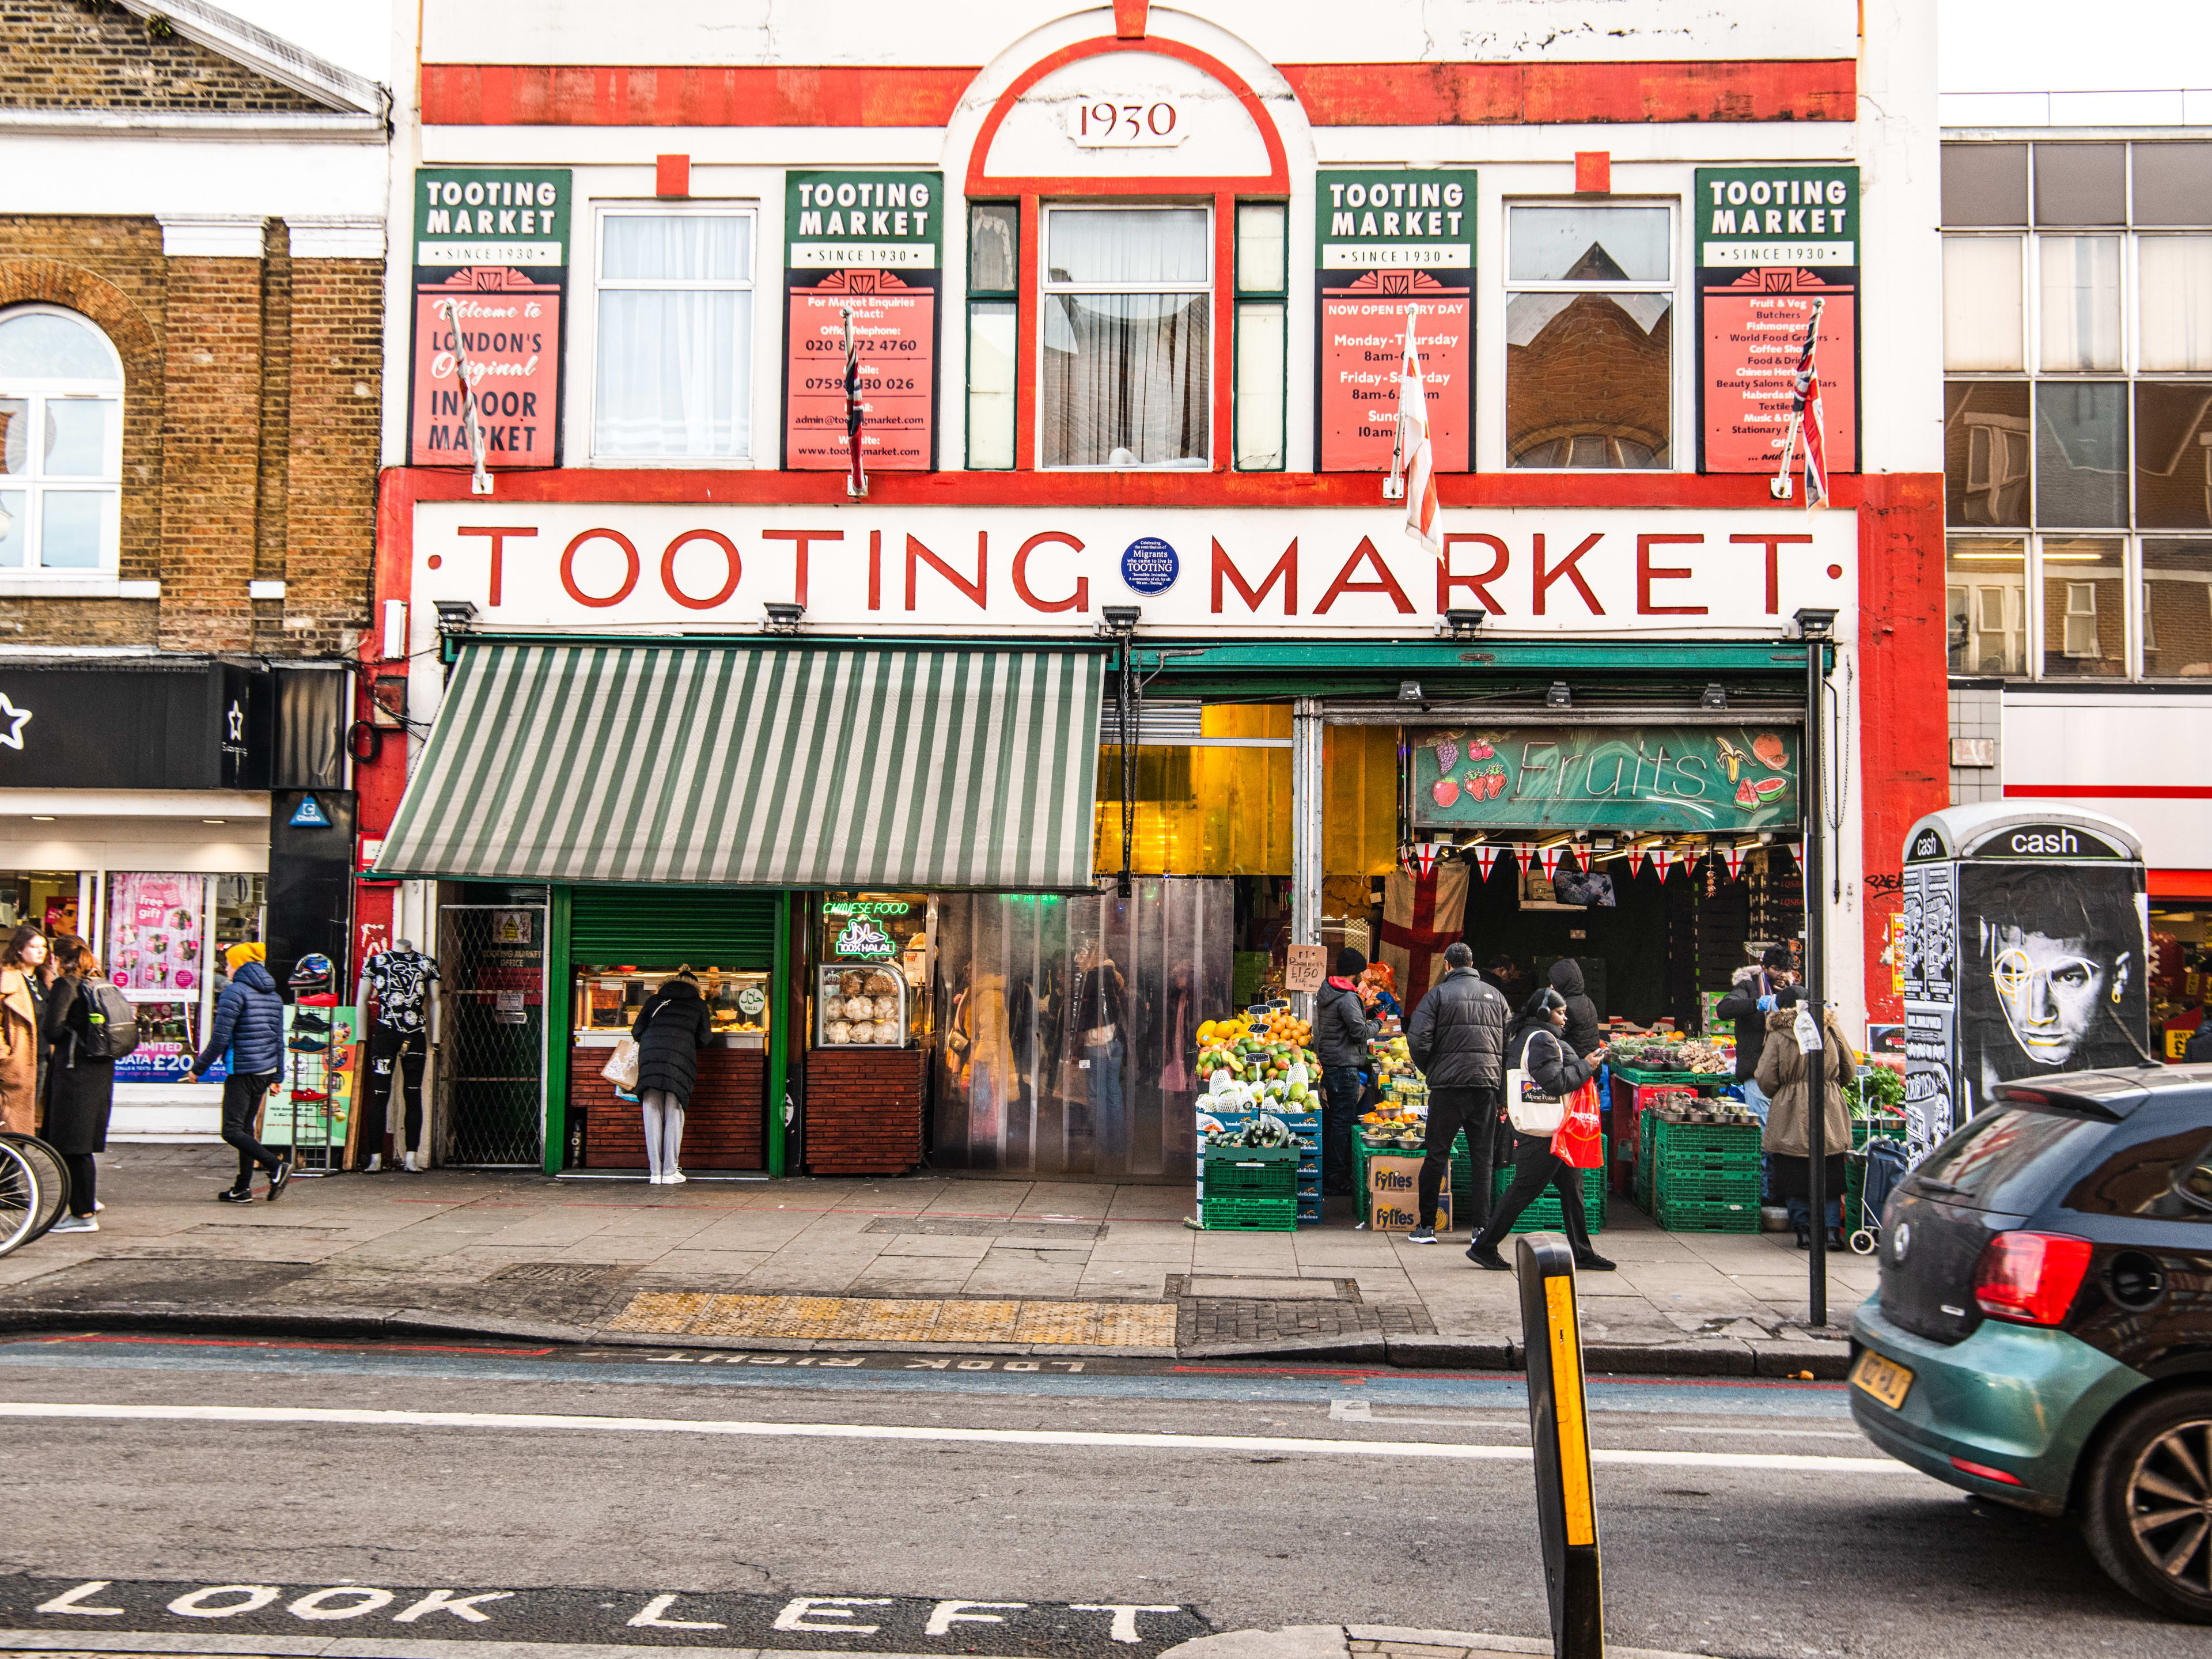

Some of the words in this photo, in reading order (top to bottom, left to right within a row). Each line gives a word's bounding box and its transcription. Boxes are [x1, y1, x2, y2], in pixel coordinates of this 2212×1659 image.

[1081, 103, 1176, 140] 1930
[426, 181, 556, 206] TOOTING
[799, 183, 929, 207] TOOTING
[1330, 183, 1464, 208] TOOTING
[1710, 180, 1846, 205] TOOTING
[426, 209, 555, 234] MARKET
[799, 211, 928, 235] MARKET
[1331, 211, 1463, 236] MARKET
[1711, 209, 1846, 234] MARKET
[446, 248, 491, 259] SINCE
[498, 249, 533, 260] 1930
[819, 250, 863, 262] SINCE
[871, 250, 906, 262] 1930
[1351, 251, 1397, 263] SINCE
[1404, 251, 1441, 263] 1930
[1733, 249, 1779, 260] SINCE
[1787, 248, 1824, 259] 1930
[524, 301, 543, 318] to
[808, 297, 825, 307] For
[828, 297, 866, 307] Market
[869, 298, 915, 309] Enquiries
[1328, 305, 1359, 315] NOW
[1361, 305, 1394, 315] OPEN
[1438, 304, 1464, 315] DAY
[1750, 299, 1774, 308] Fruit
[1777, 299, 1785, 308] &
[1787, 299, 1806, 310] Veg
[1756, 311, 1801, 319] Butchers
[853, 326, 900, 338] Telephone:
[433, 331, 542, 353] LONDON'S
[806, 340, 833, 351] 020
[880, 340, 916, 351] 4760
[1749, 344, 1782, 353] Coffee
[431, 351, 539, 386] Oiginal
[1736, 368, 1772, 377] Chinese
[887, 378, 914, 389] 026
[1717, 380, 1750, 389] Beauty
[1753, 380, 1783, 388] Salons
[1786, 380, 1793, 388] &
[1744, 414, 1772, 422] Music
[1774, 414, 1782, 422] &
[1732, 426, 1781, 435] Stationary
[1134, 550, 1168, 559] Migrants
[458, 527, 1089, 612] TOOTING
[1211, 533, 1813, 615] MARKET
[1127, 563, 1172, 571] TOOTING
[1516, 740, 1707, 797] Fruits
[1918, 832, 1936, 856] cash
[2012, 829, 2078, 853] cash
[140, 894, 164, 907] free
[138, 907, 161, 919] gift
[824, 903, 873, 914] CHINESE
[874, 903, 908, 914] FOOD
[842, 921, 886, 944] حلال
[862, 944, 892, 952] HALAL
[741, 991, 764, 1005] حلال
[153, 1054, 194, 1071] £20
[1525, 1093, 1541, 1101] Alpine
[1375, 1171, 1412, 1190] fyffes
[1377, 1209, 1414, 1228] fyffes
[647, 1352, 865, 1367] RIGHT
[904, 1360, 1085, 1372] LOOK
[35, 1580, 515, 1623] LOOK
[626, 1593, 1181, 1643] LEFT
